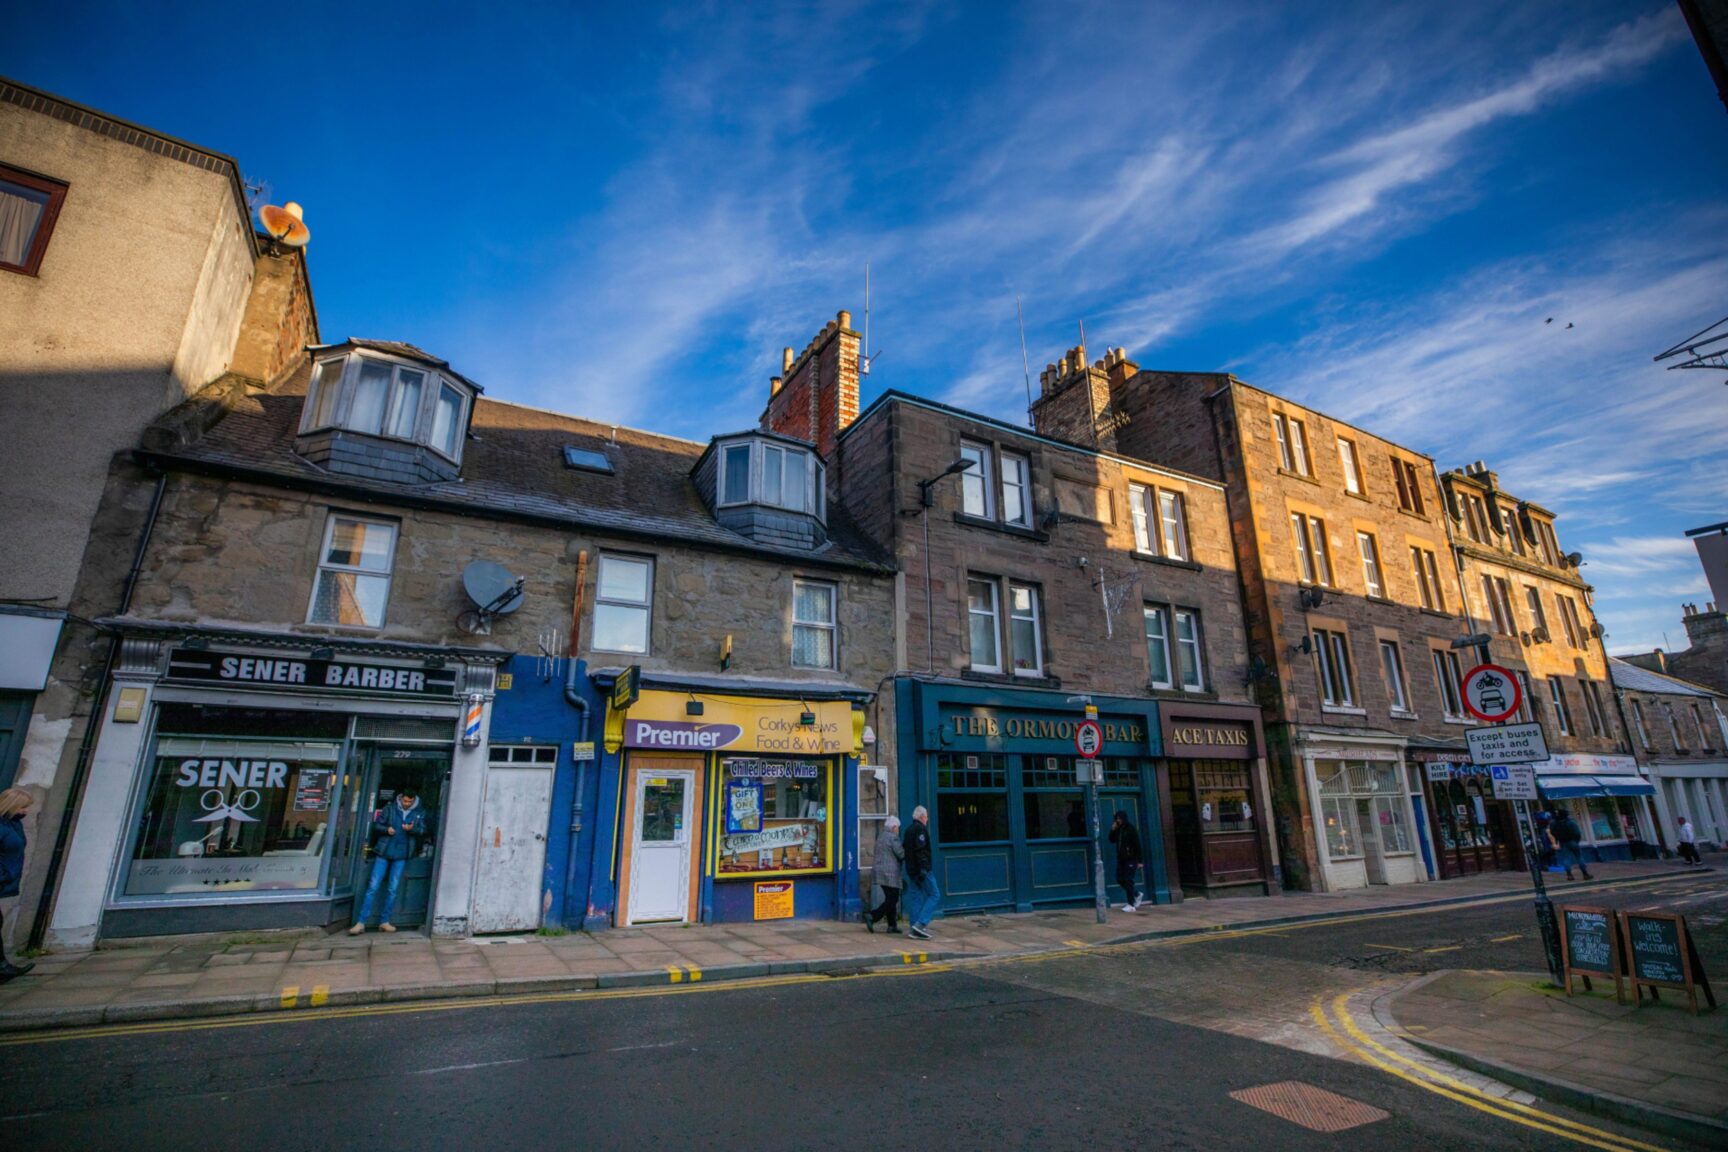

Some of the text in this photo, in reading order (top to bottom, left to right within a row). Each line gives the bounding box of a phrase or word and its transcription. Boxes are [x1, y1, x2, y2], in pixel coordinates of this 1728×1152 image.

[219, 657, 426, 691] SENER BARBER
[758, 716, 838, 734] Corkys News
[952, 715, 1000, 737] THE
[1104, 724, 1142, 743] BAR
[636, 722, 721, 747] Premier
[1172, 727, 1248, 745] ACE TAXIS
[1469, 729, 1539, 742] Except buses
[756, 735, 840, 751] Food & Wine
[1481, 738, 1529, 750] taxis and
[1481, 749, 1535, 759] for access
[175, 759, 288, 788] SENER
[730, 759, 817, 778] Chilled Beers & Wines
[1430, 764, 1447, 772] KILT
[1431, 771, 1448, 779] HIRE
[735, 789, 754, 798] GIFT
[758, 885, 784, 893] Premier
